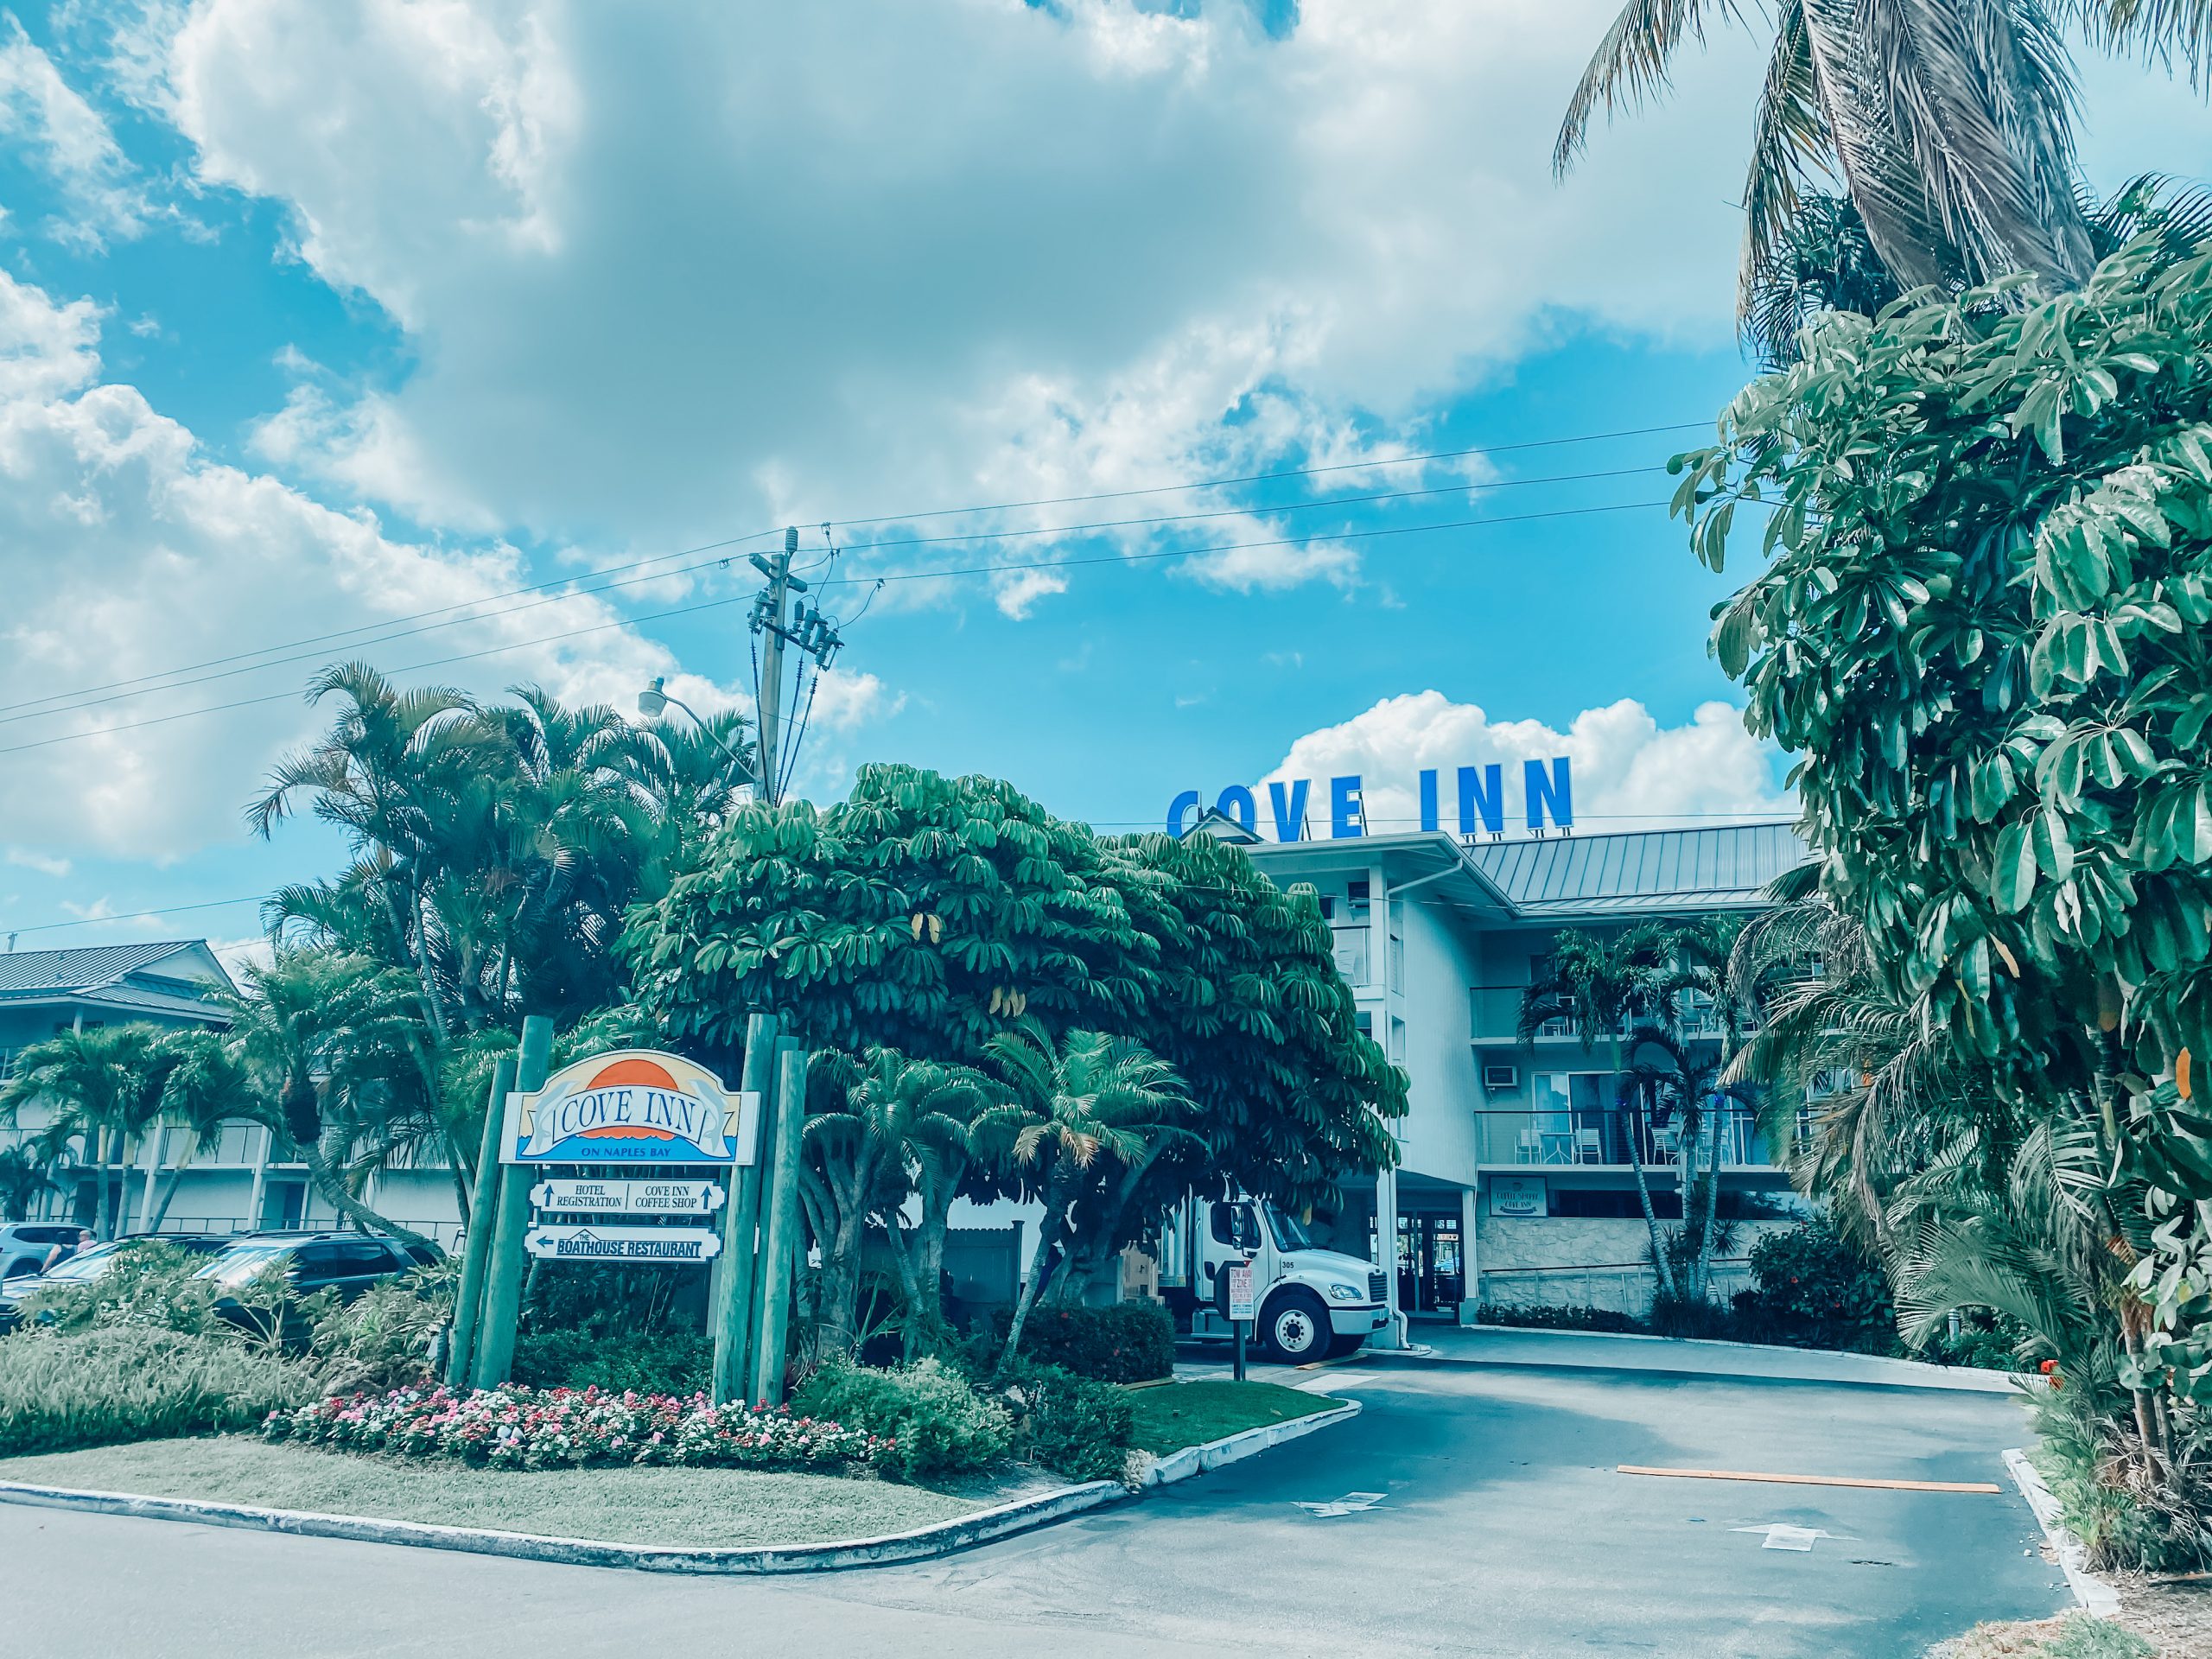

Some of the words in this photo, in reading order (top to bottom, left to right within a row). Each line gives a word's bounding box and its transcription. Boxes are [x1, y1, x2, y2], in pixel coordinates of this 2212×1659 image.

[1166, 775, 1363, 843] COVE
[1419, 756, 1573, 836] INN
[562, 1090, 632, 1133] COVE
[644, 1091, 696, 1134] INN
[582, 1147, 599, 1157] ON
[604, 1147, 645, 1157] NAPLES
[651, 1147, 671, 1157] BAY
[575, 1185, 605, 1195] HOTEL
[645, 1185, 670, 1196] COVE
[672, 1186, 690, 1196] INN
[557, 1197, 622, 1207] REGISTRATION
[635, 1198, 671, 1208] COFFEE
[671, 1198, 696, 1208] SHOP
[557, 1240, 624, 1255] BOATHOUSE
[627, 1242, 702, 1258] RESTAURANT
